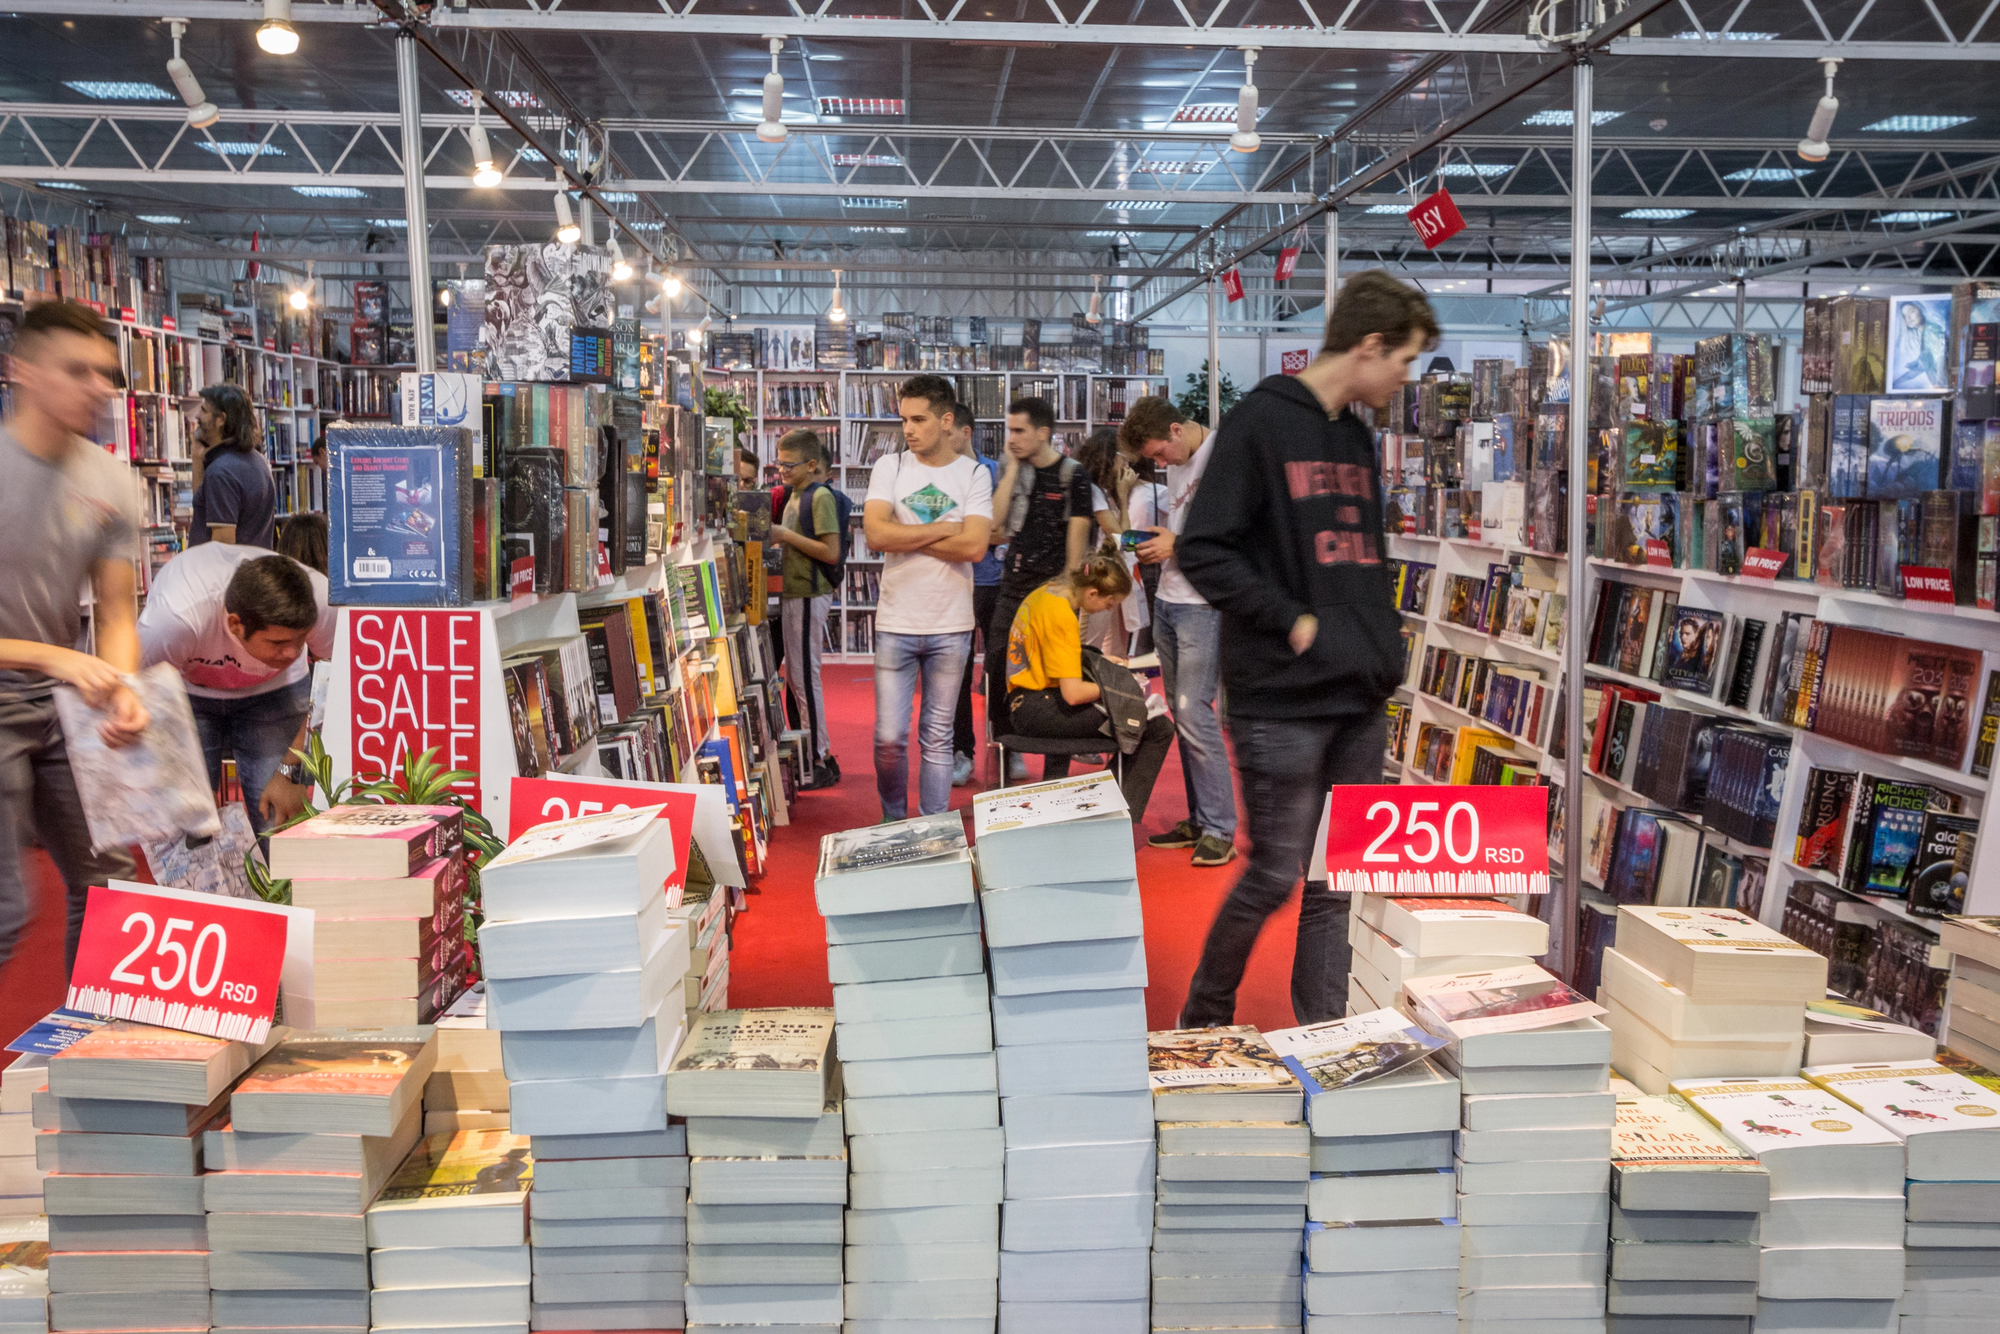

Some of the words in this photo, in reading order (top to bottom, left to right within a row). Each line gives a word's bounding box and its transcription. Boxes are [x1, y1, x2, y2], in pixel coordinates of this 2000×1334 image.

[1977, 289, 2000, 299] SUZAN
[571, 334, 585, 374] HARRY
[585, 335, 598, 376] POTTER
[1283, 354, 1307, 365] BOOK
[1284, 361, 1306, 371] SHOP
[1620, 358, 1648, 375] TOLKIEN
[407, 388, 415, 402] AYN
[407, 403, 415, 421] RAND
[1877, 411, 1934, 427] TRIPODS
[1744, 556, 1762, 569] LOW
[1761, 558, 1782, 571] PRICE
[519, 567, 533, 584] PRICE
[1905, 576, 1923, 589] LOW
[1924, 577, 1950, 592] PRICE
[355, 614, 475, 672] SALE
[356, 674, 476, 731] SALE
[1815, 772, 1839, 828] RISING
[1362, 801, 1480, 864] 250
[1485, 847, 1525, 864] RSD
[1808, 834, 1829, 866] RED
[110, 911, 228, 998] 250
[220, 980, 258, 1005] RSD
[1287, 1018, 1381, 1042] IBSEN
[1152, 1071, 1268, 1084] KIDNAPPED
[1823, 1066, 1947, 1082] SHAKESPEARE
[1690, 1083, 1813, 1095] SHAKESPEARE
[1909, 1097, 1944, 1105] Henry
[1615, 1115, 1668, 1124] RISE
[1768, 1112, 1804, 1120] Henry
[1616, 1145, 1729, 1155] LAPHAM
